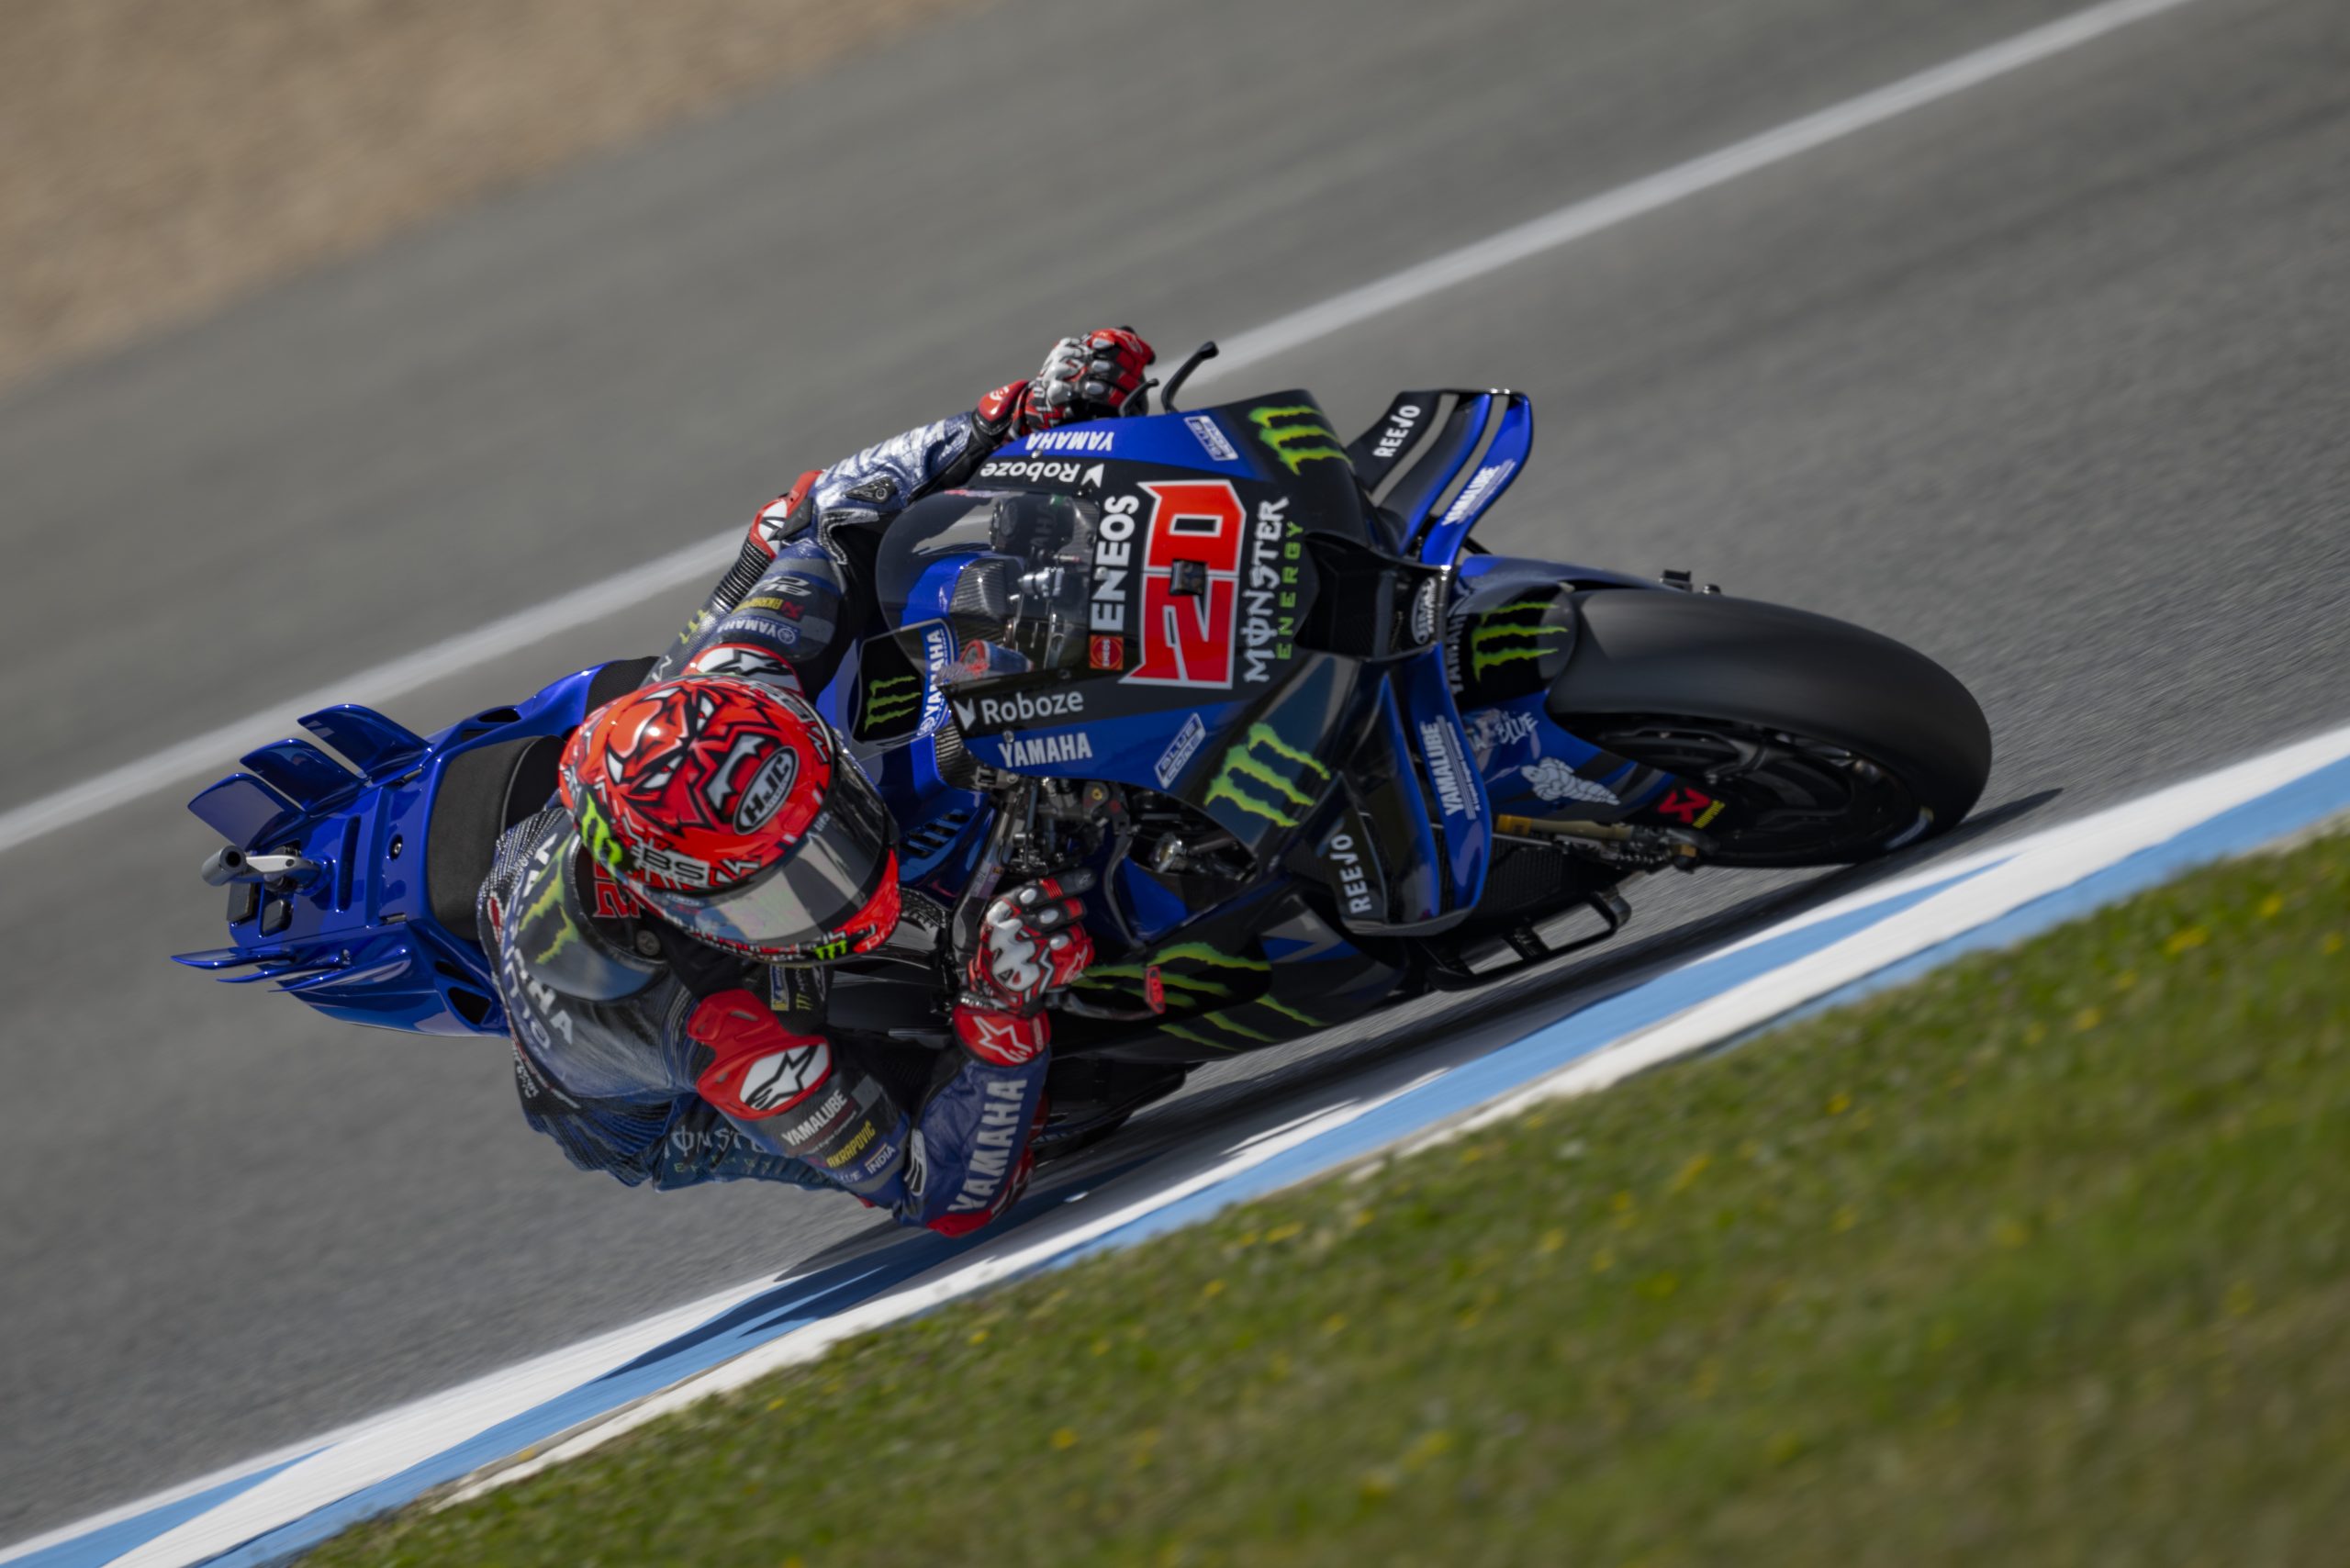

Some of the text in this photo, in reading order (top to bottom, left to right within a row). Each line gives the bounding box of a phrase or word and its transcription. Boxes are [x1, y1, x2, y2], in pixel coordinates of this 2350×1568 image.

[979, 462, 1081, 483] Roboze
[1025, 431, 1114, 452] YAMAHA
[1090, 495, 1139, 632] ENEOS
[1118, 478, 1247, 689] 20
[1240, 496, 1290, 683] MONSTER
[1276, 521, 1304, 660] ENERGY
[980, 691, 1084, 724] Roboze
[998, 733, 1092, 767] YAMAHA
[1419, 721, 1464, 816] YAMALUBE
[744, 755, 789, 825] HJC
[781, 1089, 847, 1147] YAMALUBE
[947, 1079, 1027, 1212] YAMAHA
[865, 1145, 897, 1175] INDIA
